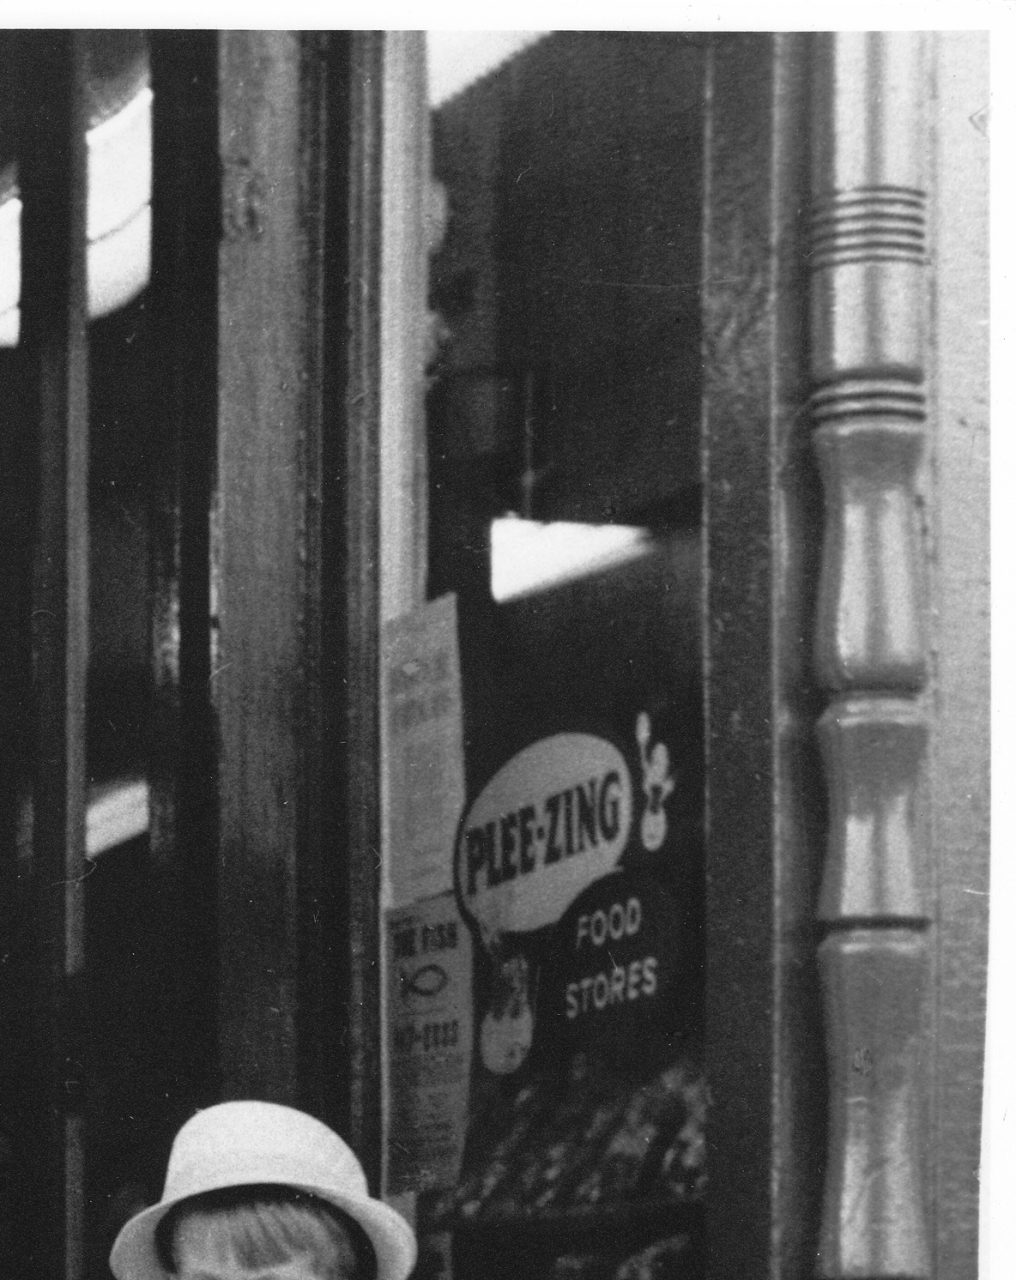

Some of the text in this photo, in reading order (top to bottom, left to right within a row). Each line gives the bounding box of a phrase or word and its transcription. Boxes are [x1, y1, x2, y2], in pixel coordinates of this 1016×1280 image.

[466, 771, 621, 896] PLEE-ZING
[578, 898, 641, 949] FOOD
[567, 956, 658, 1020] STORES
